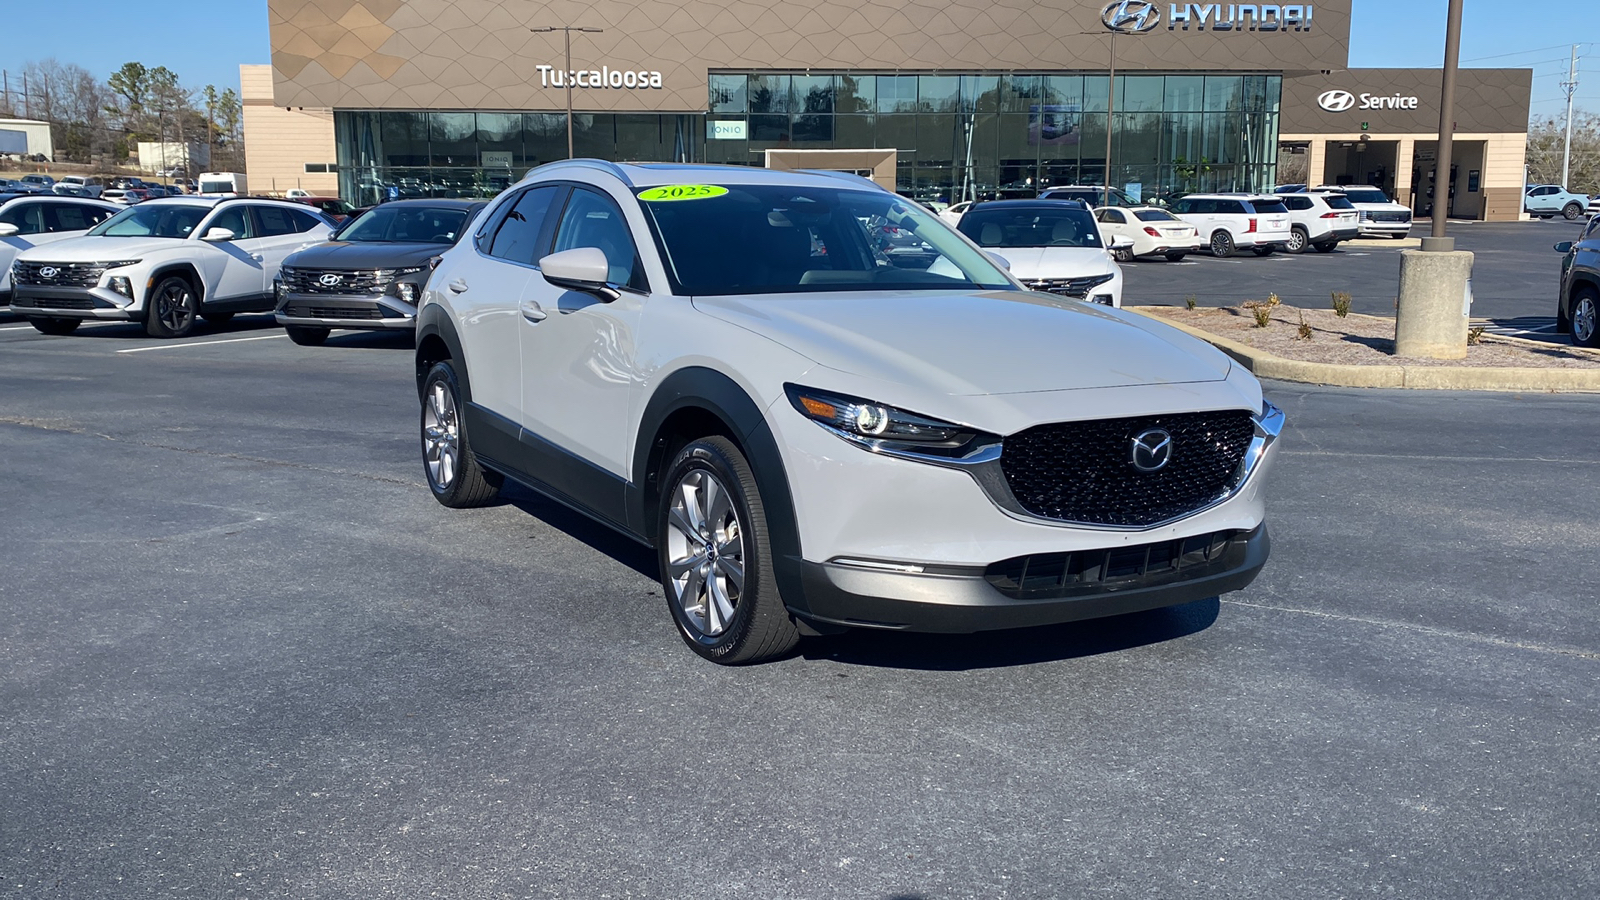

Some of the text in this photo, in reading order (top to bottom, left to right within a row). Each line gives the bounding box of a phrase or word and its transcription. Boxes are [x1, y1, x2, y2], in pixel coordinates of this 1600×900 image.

[1168, 4, 1313, 31] HYUNDAI
[535, 65, 662, 89] Tuscaloosa
[1358, 93, 1418, 110] Service
[711, 126, 741, 134] IONIQ
[656, 186, 710, 199] 2025
